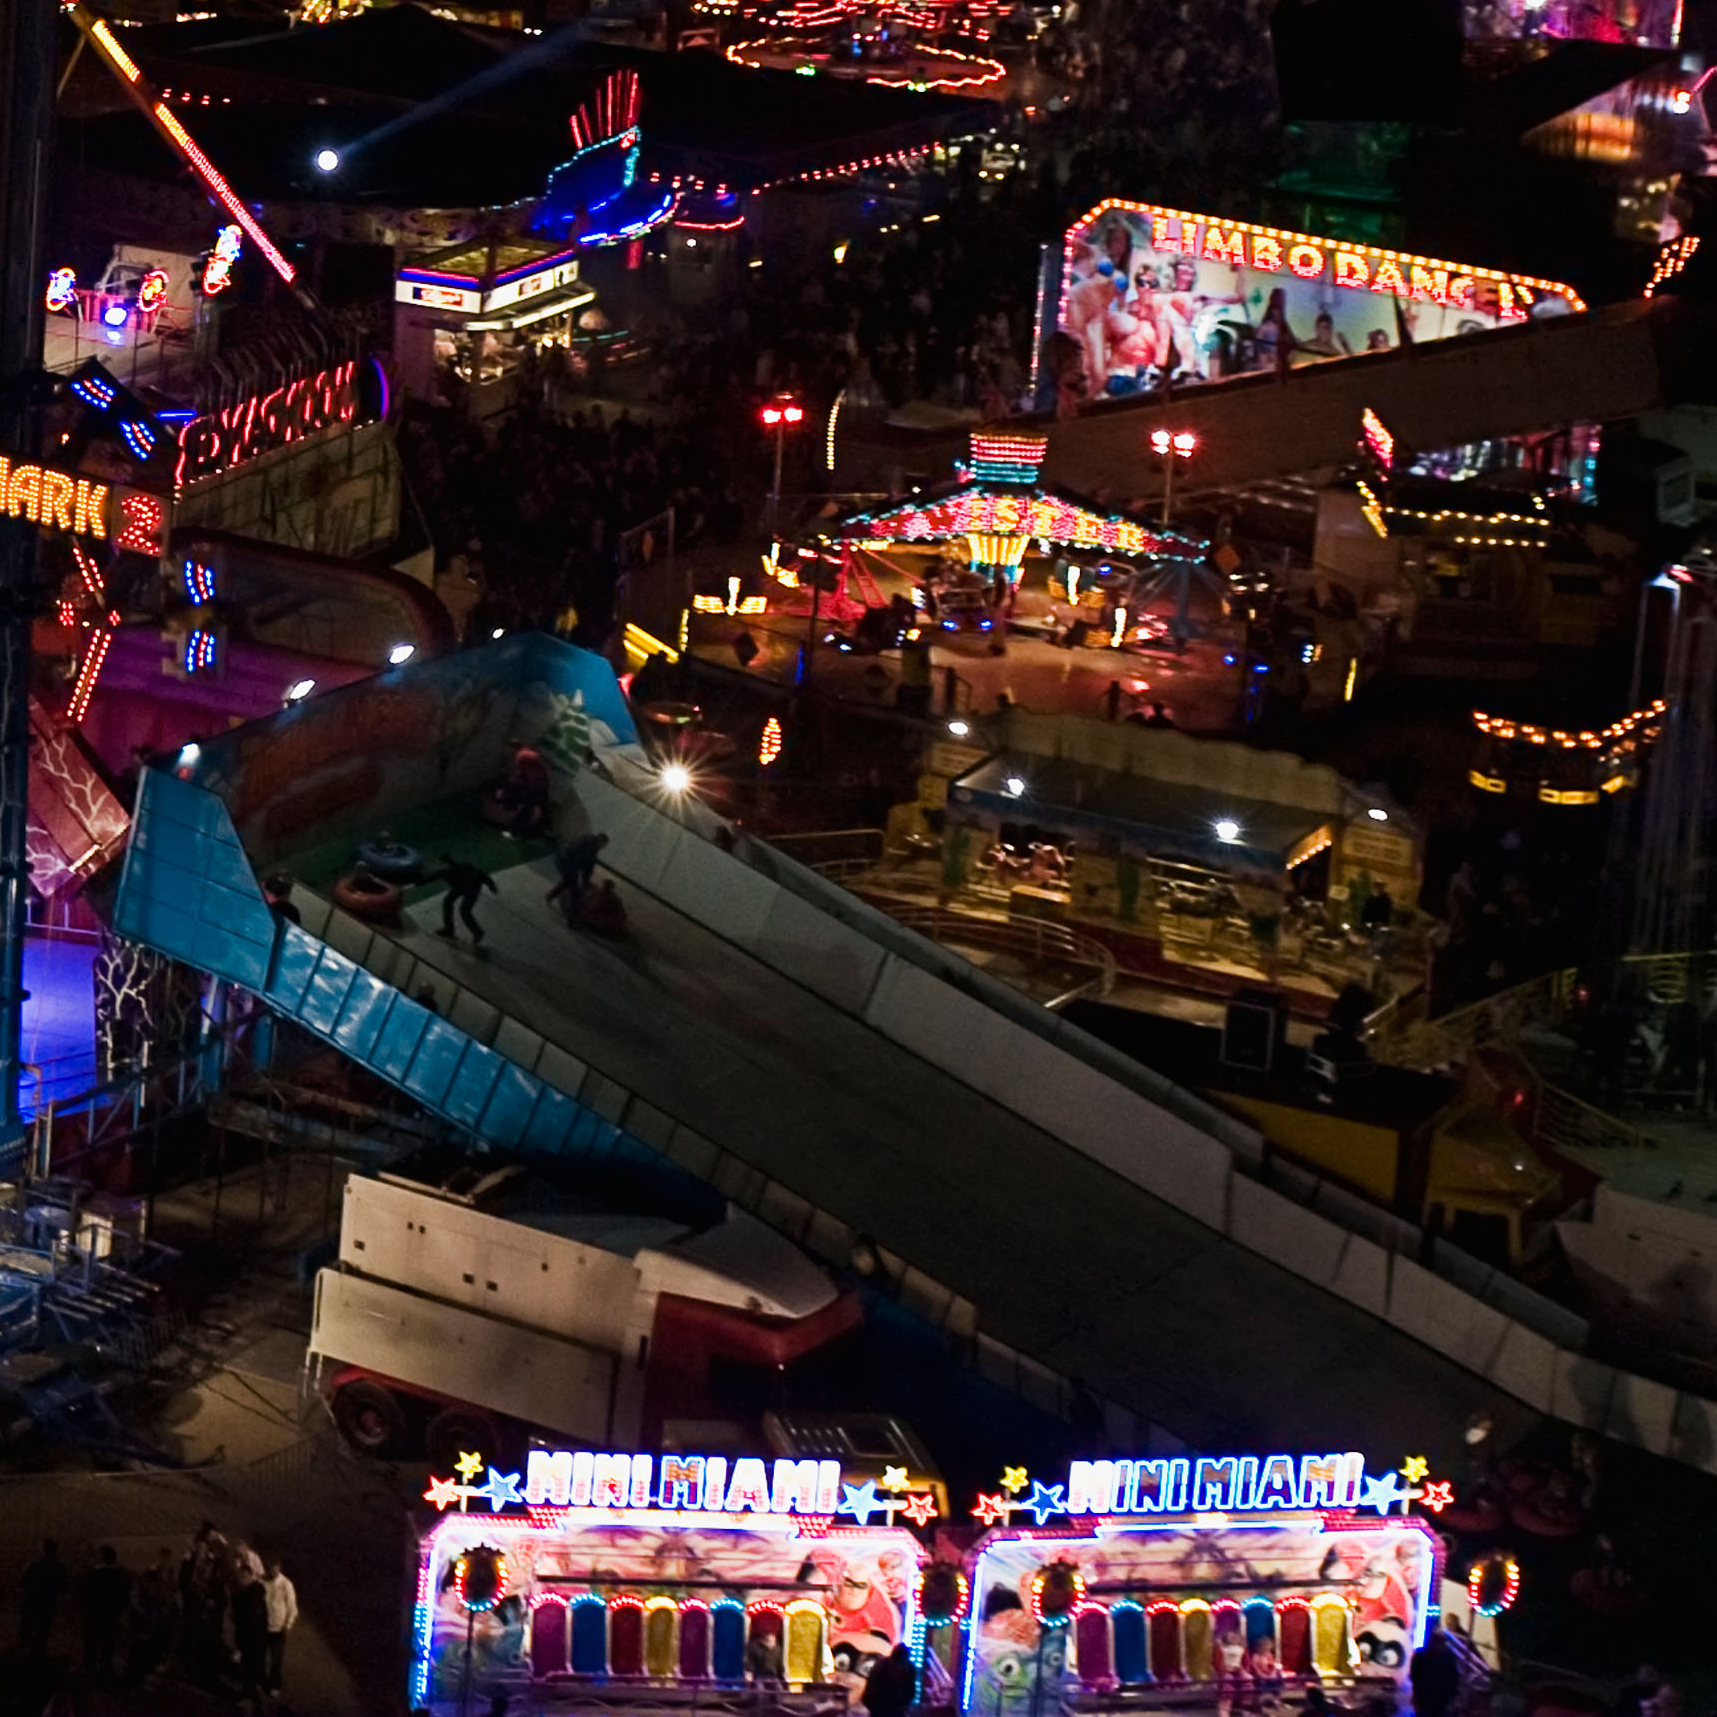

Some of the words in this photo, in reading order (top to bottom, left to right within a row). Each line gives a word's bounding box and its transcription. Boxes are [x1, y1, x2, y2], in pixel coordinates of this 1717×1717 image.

[1152, 215, 1325, 278] LIMBO
[115, 494, 163, 556] 2
[526, 1450, 653, 1508] MINI
[661, 1455, 842, 1514] MIAMI
[1068, 1460, 1190, 1514] MINI
[1193, 1452, 1366, 1511] MIAMI
